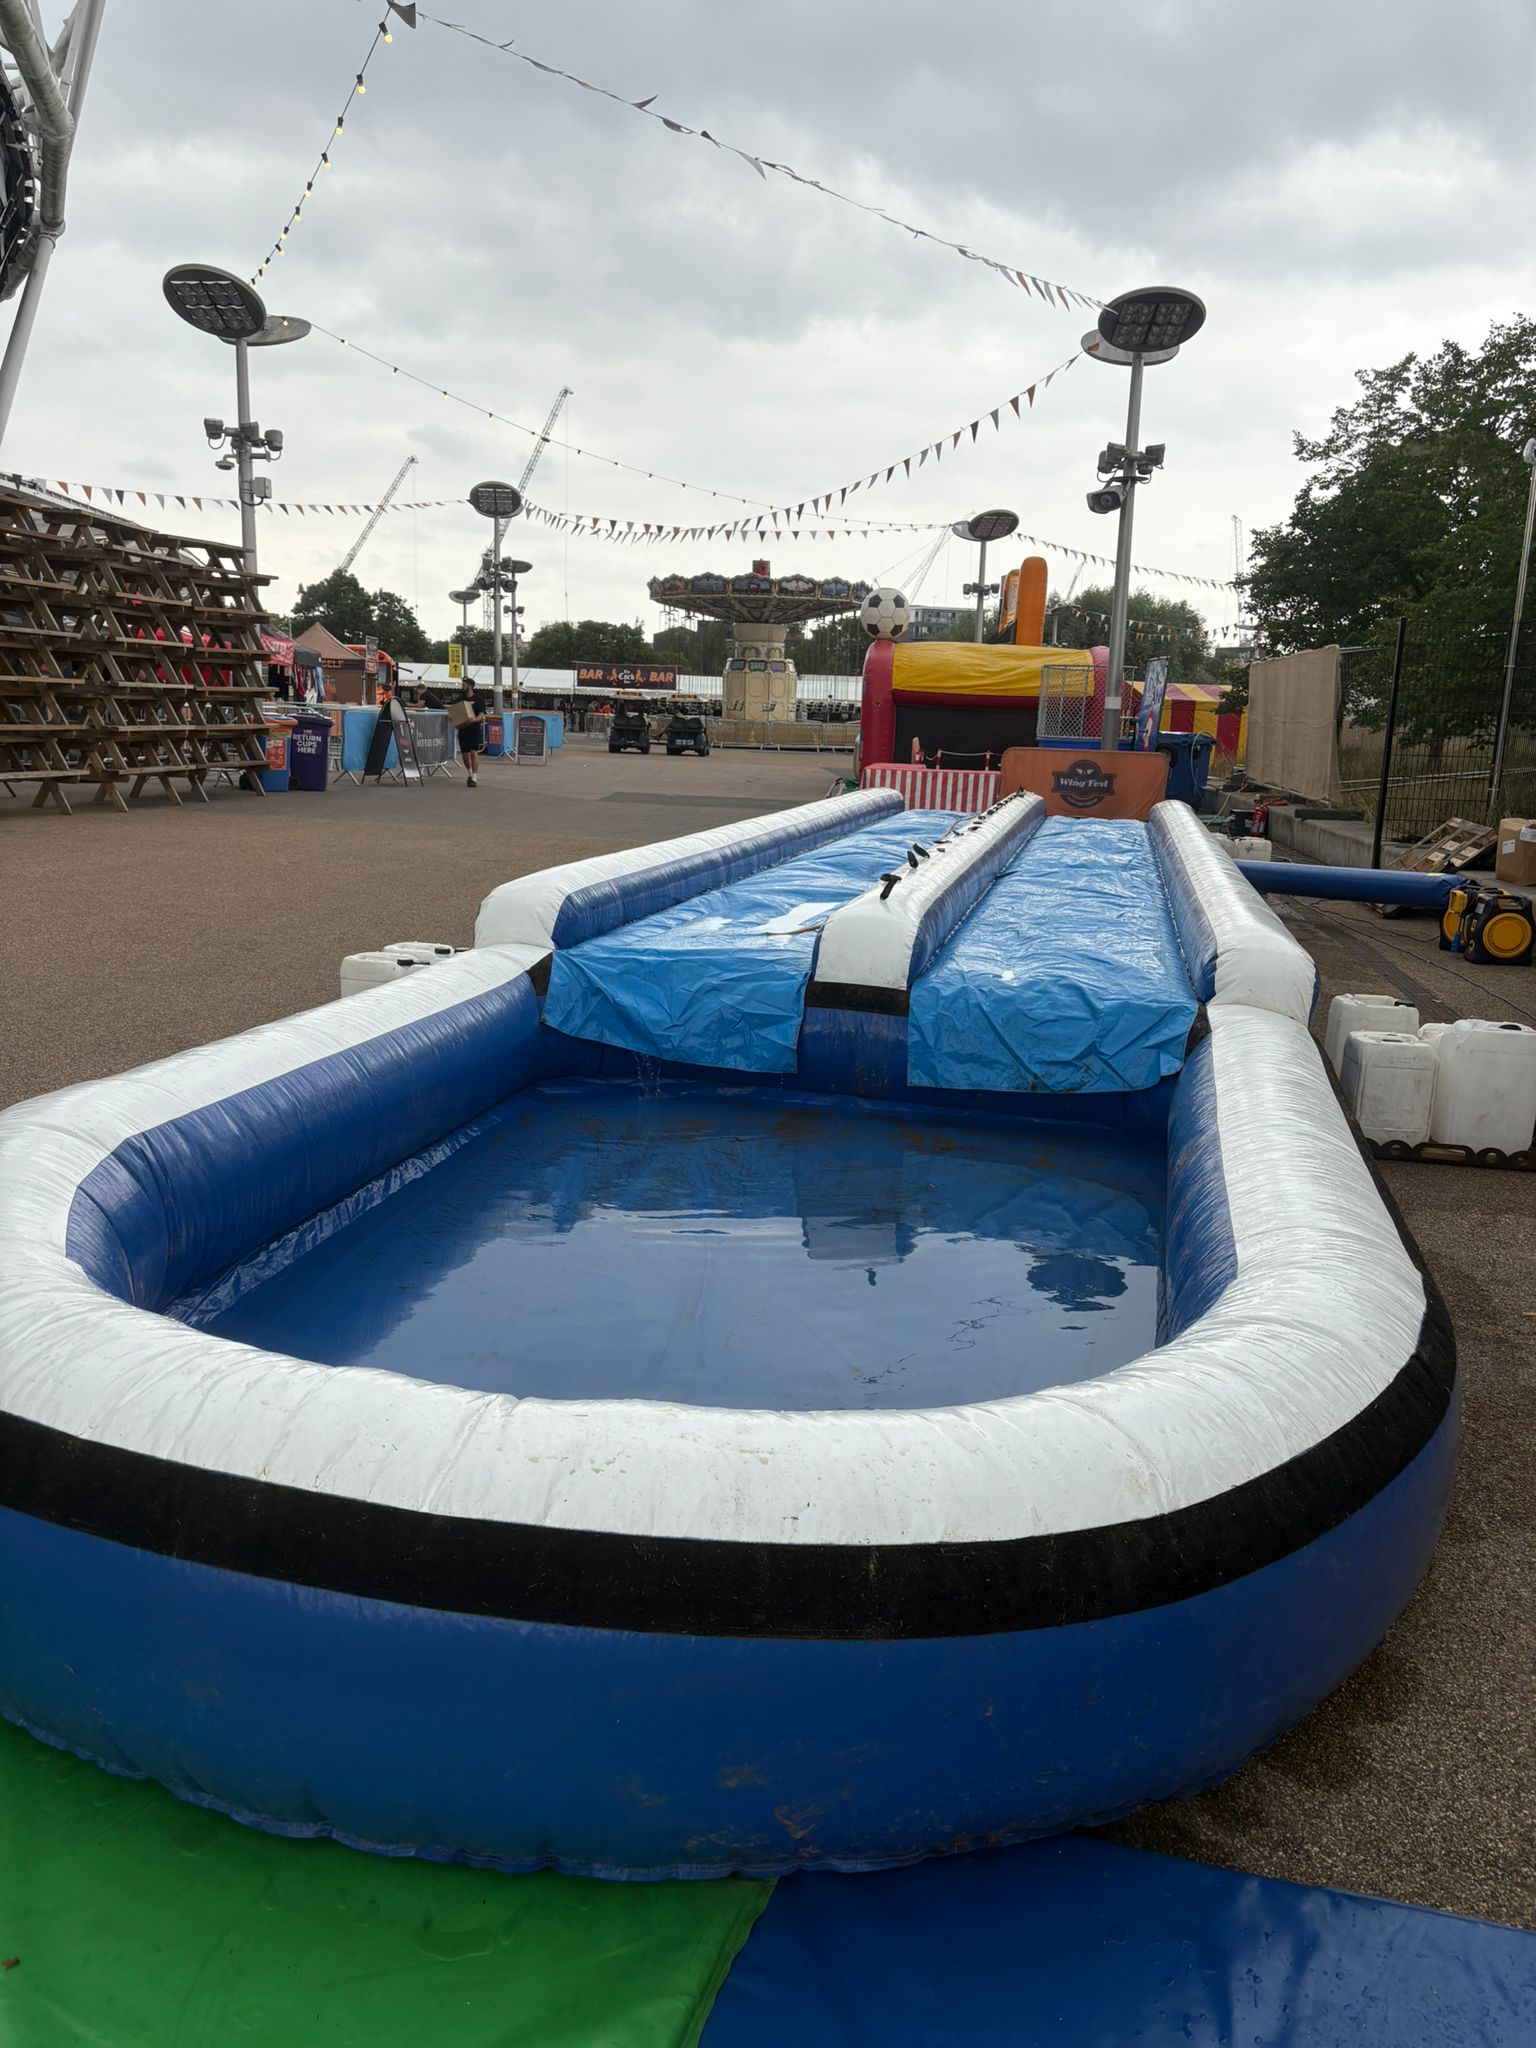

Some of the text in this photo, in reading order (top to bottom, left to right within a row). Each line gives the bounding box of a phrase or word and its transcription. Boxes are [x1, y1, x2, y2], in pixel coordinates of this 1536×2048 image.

[579, 668, 604, 680] BAR
[649, 671, 673, 682] BAR
[292, 733, 322, 743] RETURN
[296, 740, 317, 748] CUPS
[297, 747, 316, 755] HERE
[1060, 777, 1109, 788] Wing Fest
